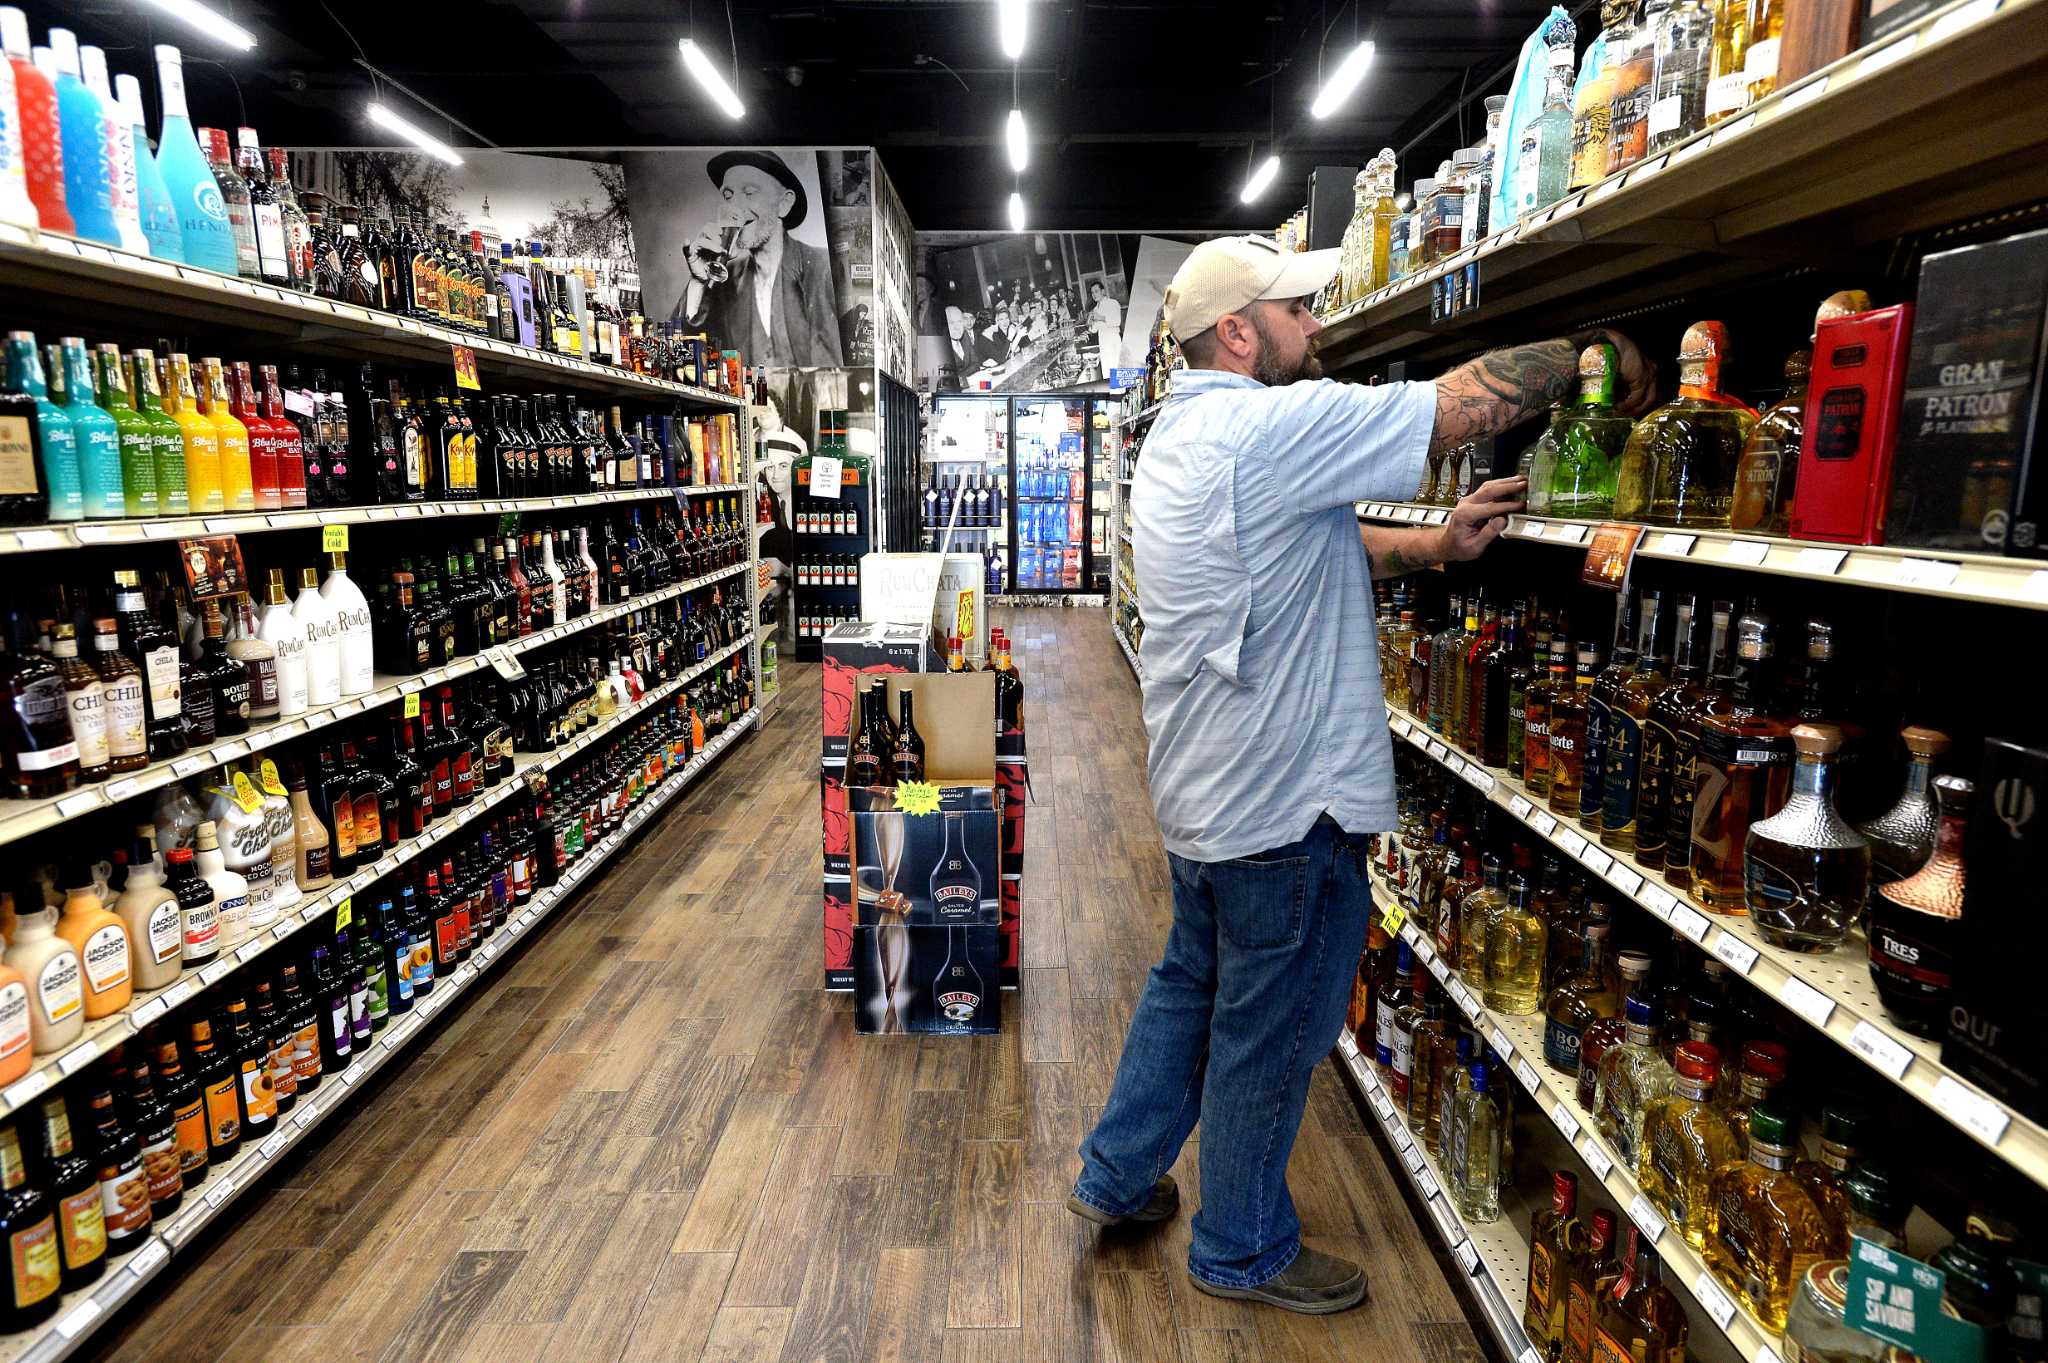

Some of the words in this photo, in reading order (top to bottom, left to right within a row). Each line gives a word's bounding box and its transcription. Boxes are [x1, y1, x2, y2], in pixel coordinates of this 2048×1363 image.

[1939, 360, 2005, 386] GRAN
[104, 687, 143, 701] CHIL
[222, 682, 250, 697] BOUR
[73, 695, 103, 711] CHI
[1550, 735, 1574, 751] uerte
[1673, 750, 1697, 780] G4
[938, 886, 977, 900] BAILEYS
[940, 905, 973, 914] Caramel
[151, 912, 178, 929] JACKSON
[152, 919, 179, 935] MORGAN
[86, 937, 125, 958] JACKSON
[88, 944, 125, 963] MORGAN
[1882, 935, 1920, 960] TRES
[43, 964, 77, 985] JACKSON
[44, 972, 78, 991] MORGAN
[941, 993, 977, 1004] BAILEYS
[0, 1003, 26, 1022] ORGAN
